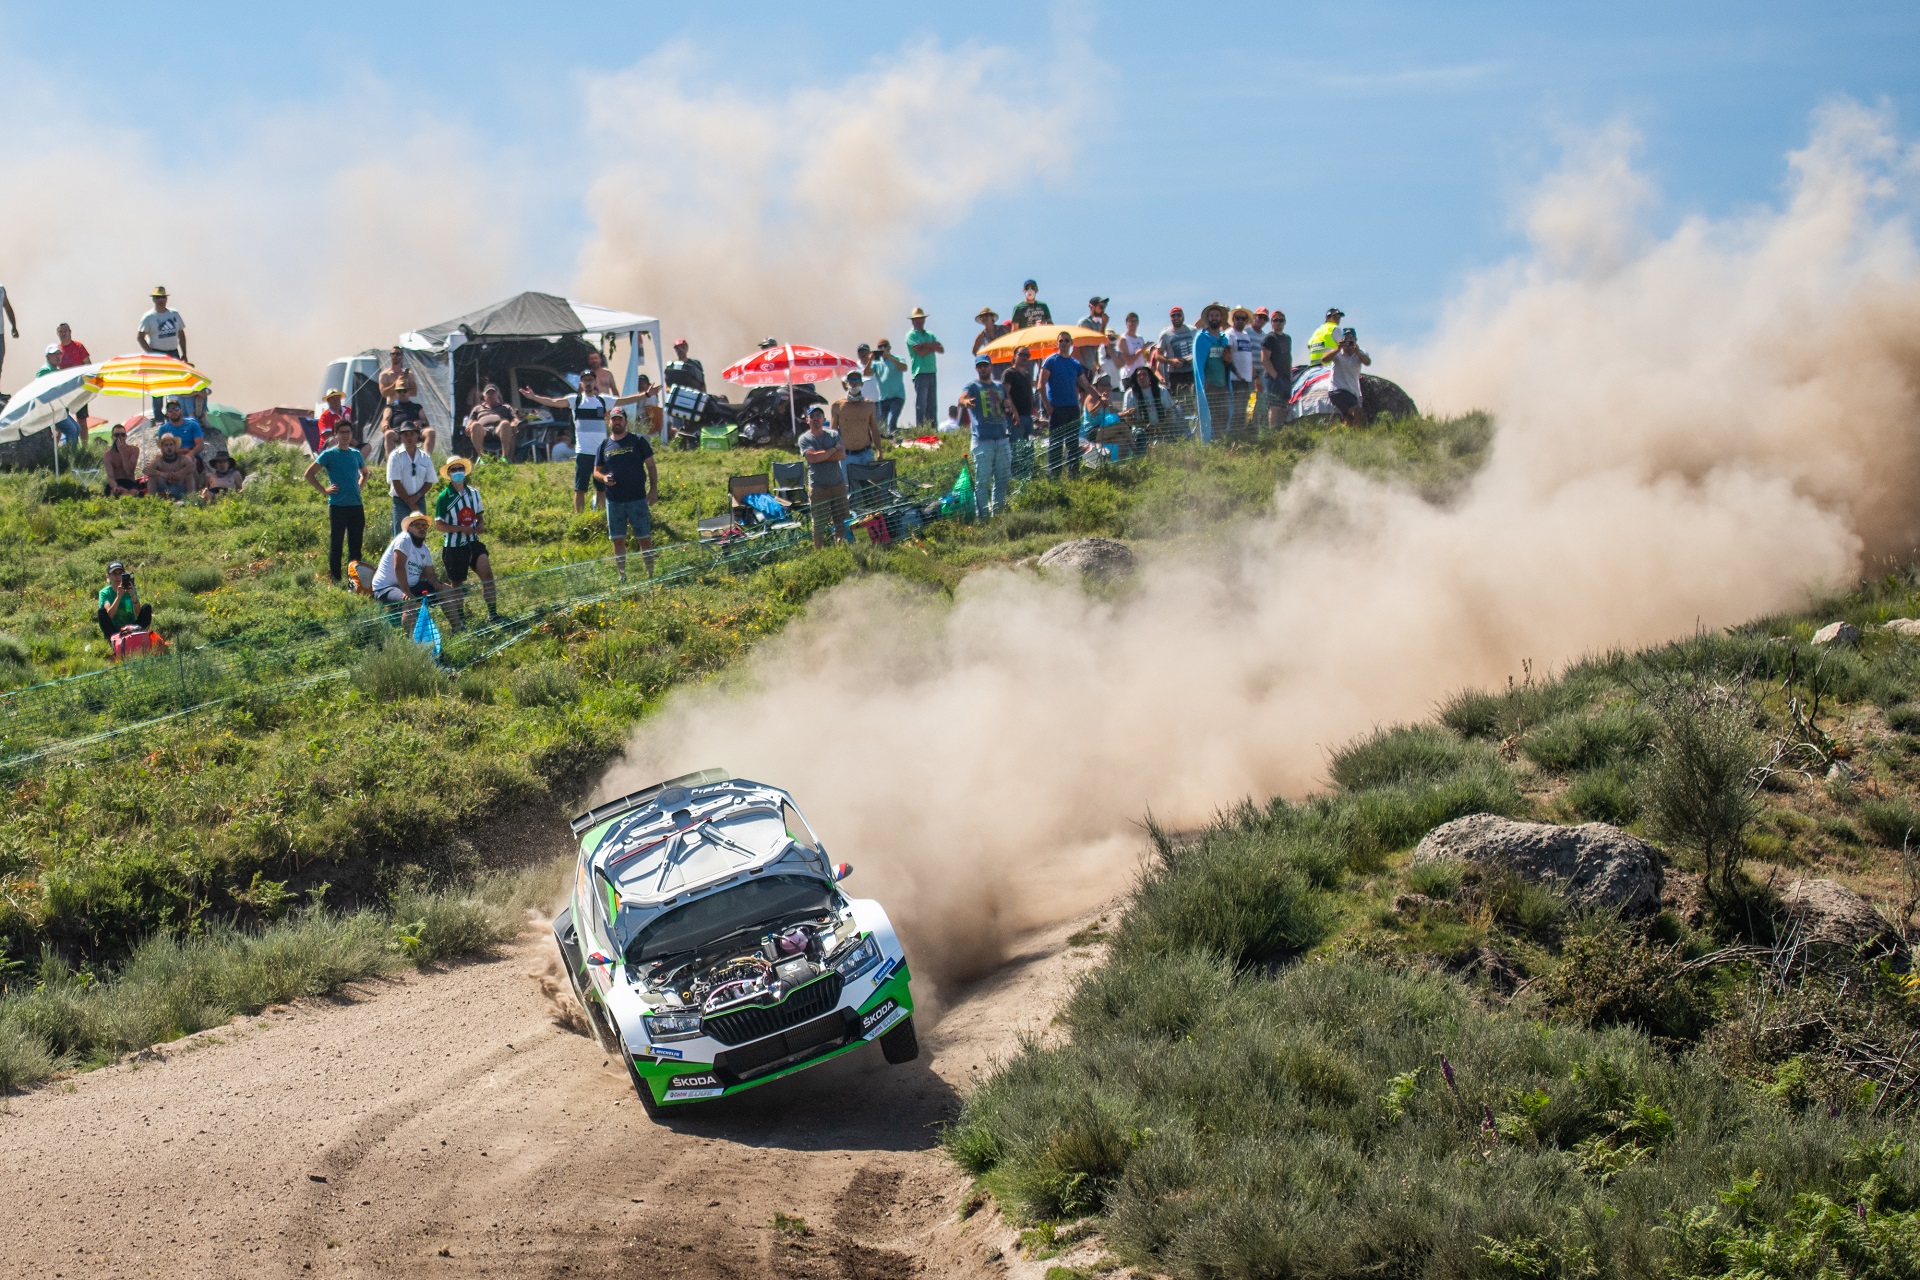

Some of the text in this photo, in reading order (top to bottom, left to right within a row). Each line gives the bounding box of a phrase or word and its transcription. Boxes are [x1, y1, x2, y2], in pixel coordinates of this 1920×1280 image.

[863, 1001, 893, 1029] ŠKODA
[882, 1010, 900, 1029] EDGE
[673, 1076, 716, 1087] ŠKODA
